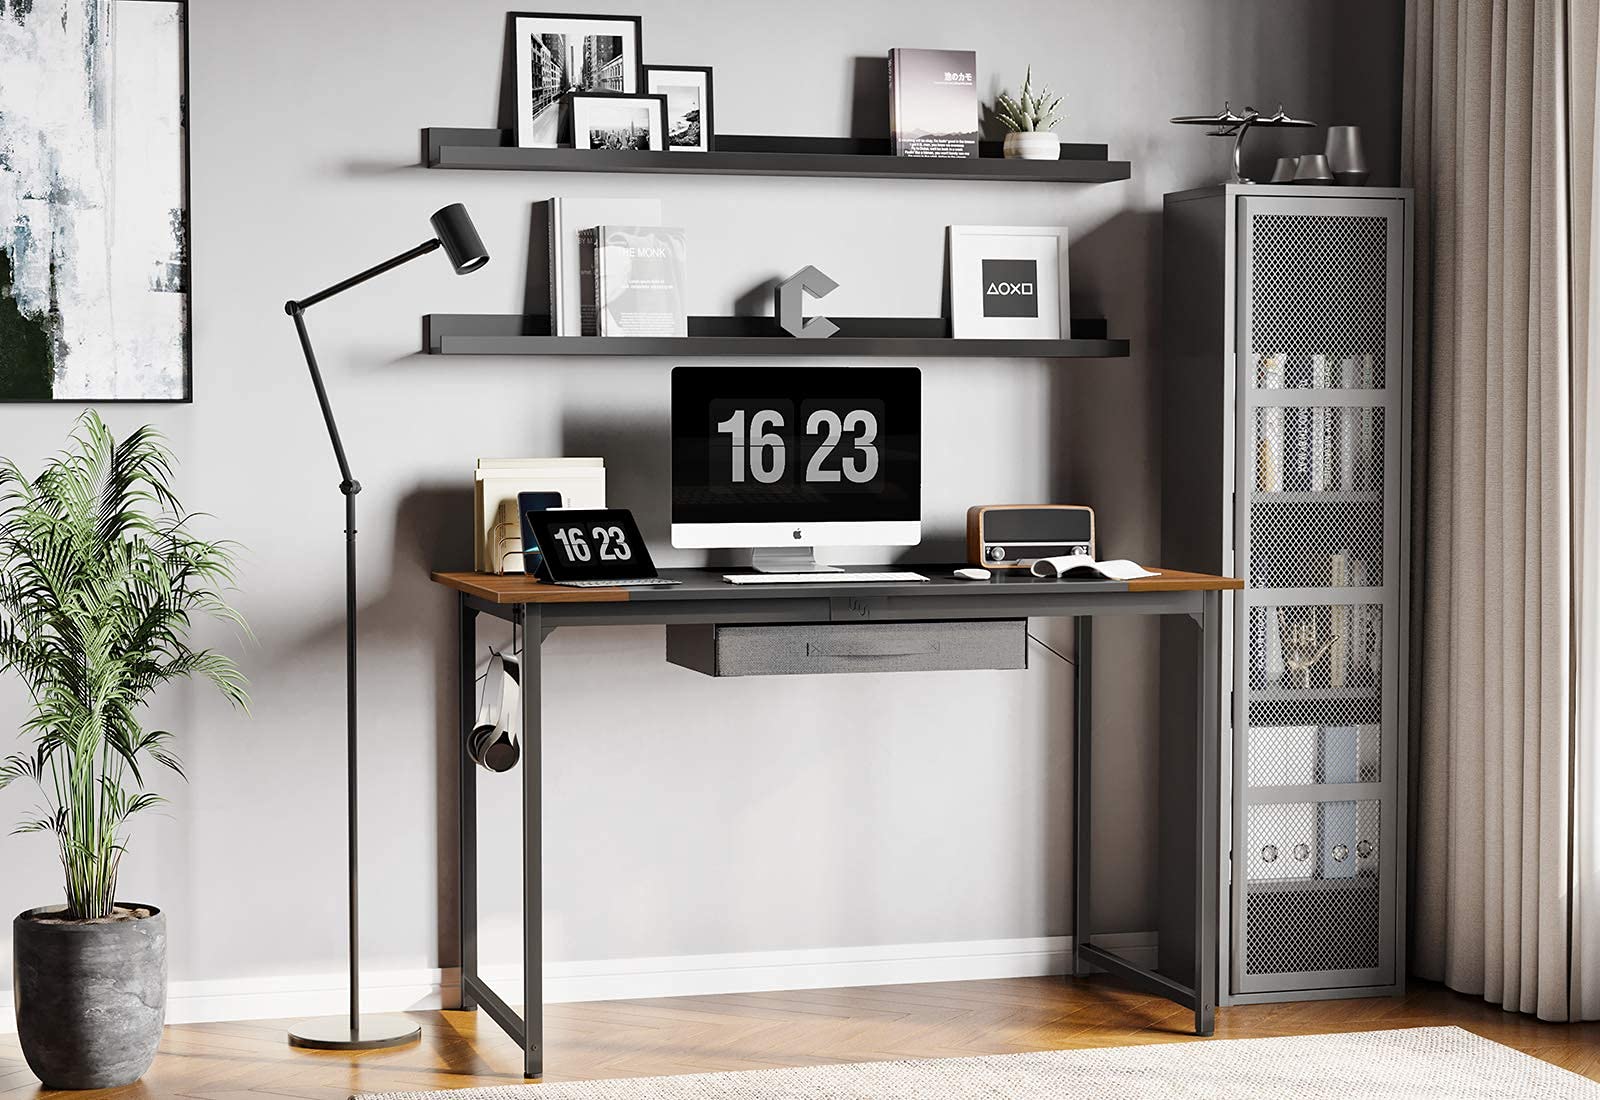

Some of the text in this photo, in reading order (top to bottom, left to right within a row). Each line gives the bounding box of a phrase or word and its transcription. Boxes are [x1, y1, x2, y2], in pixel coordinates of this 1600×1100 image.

[618, 247, 666, 258] HE MONK
[717, 409, 879, 484] 16 23
[554, 526, 632, 562] 16 23
